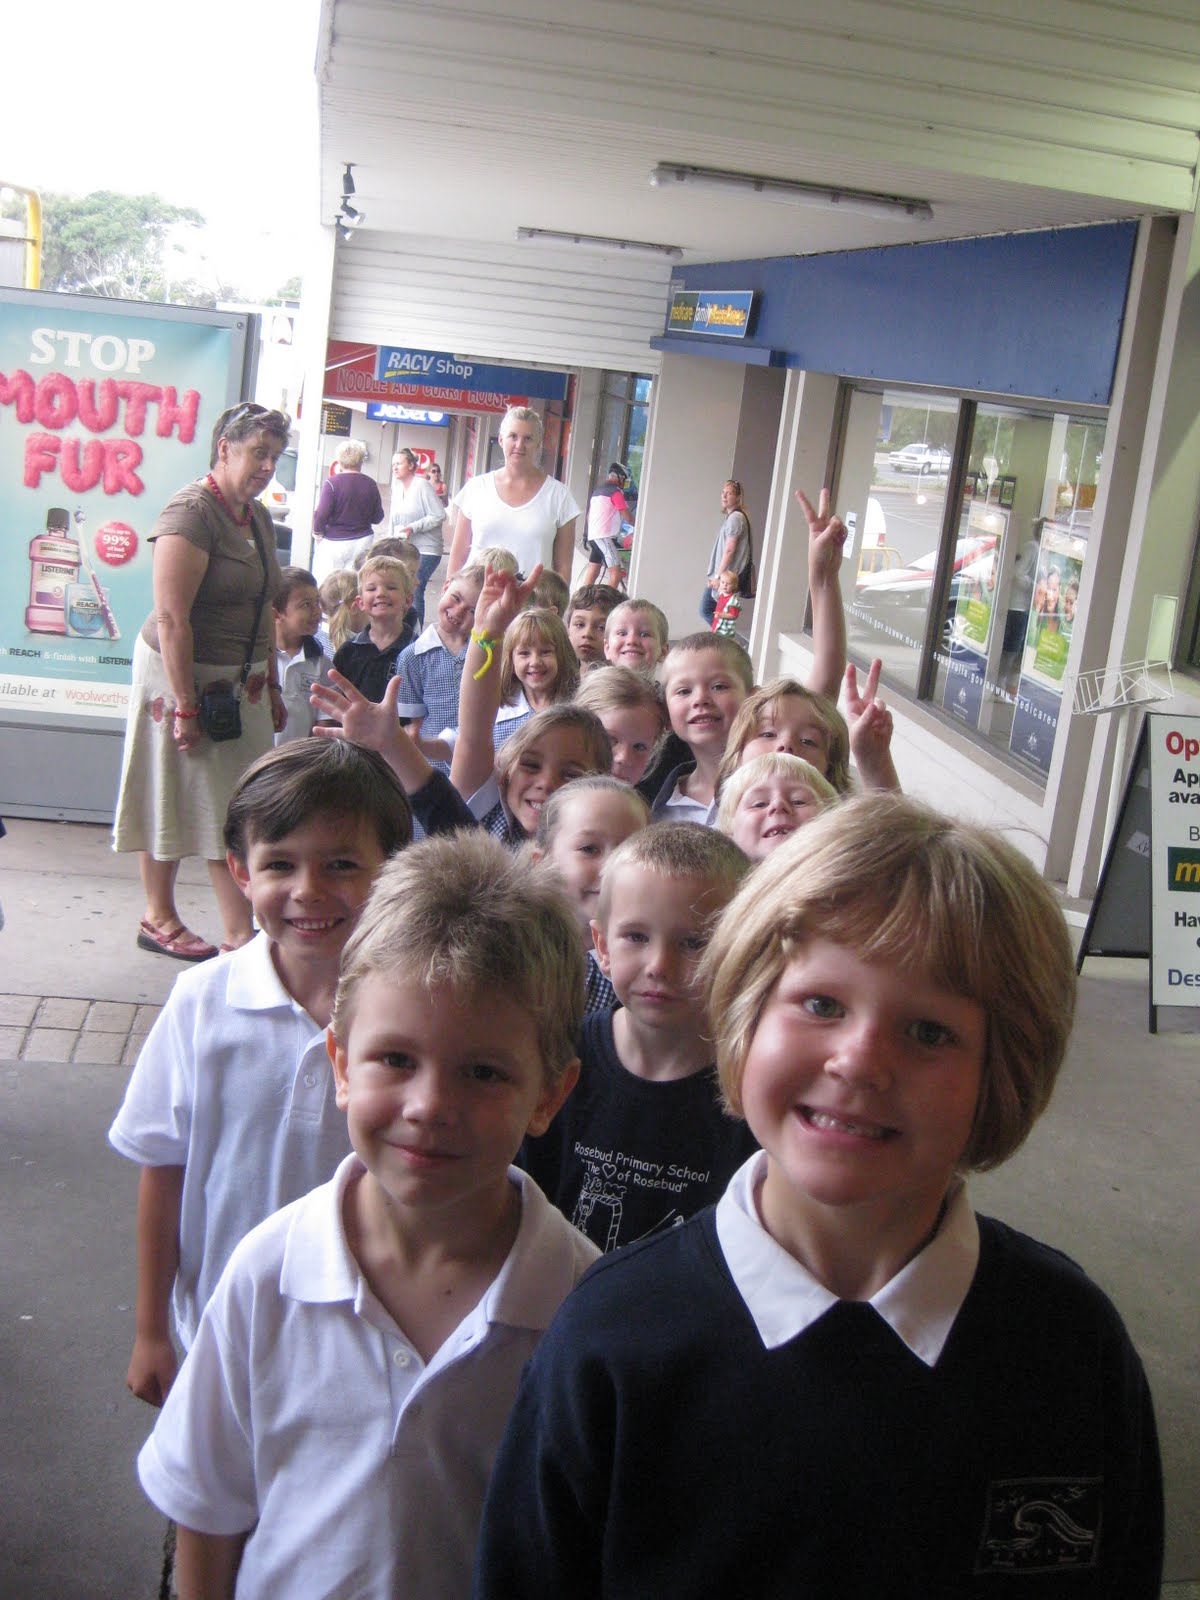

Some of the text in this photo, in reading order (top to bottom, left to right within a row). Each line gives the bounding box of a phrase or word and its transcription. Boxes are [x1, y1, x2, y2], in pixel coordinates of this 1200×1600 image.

[30, 328, 156, 374] STOP
[387, 351, 473, 380] RACV Shop
[0, 369, 201, 444] MOUTH
[24, 432, 145, 497] FUR
[103, 534, 130, 547] 99%
[41, 564, 75, 576] LISTERINE
[9, 648, 41, 658] REACH
[53, 652, 77, 662] finish
[79, 655, 97, 664] with
[0, 682, 39, 697] ilable
[43, 688, 56, 698] at
[1173, 768, 1200, 788] Ap
[1169, 791, 1200, 805] ava
[574, 1141, 710, 1183] Rosebud Primary School
[617, 1170, 631, 1181] of
